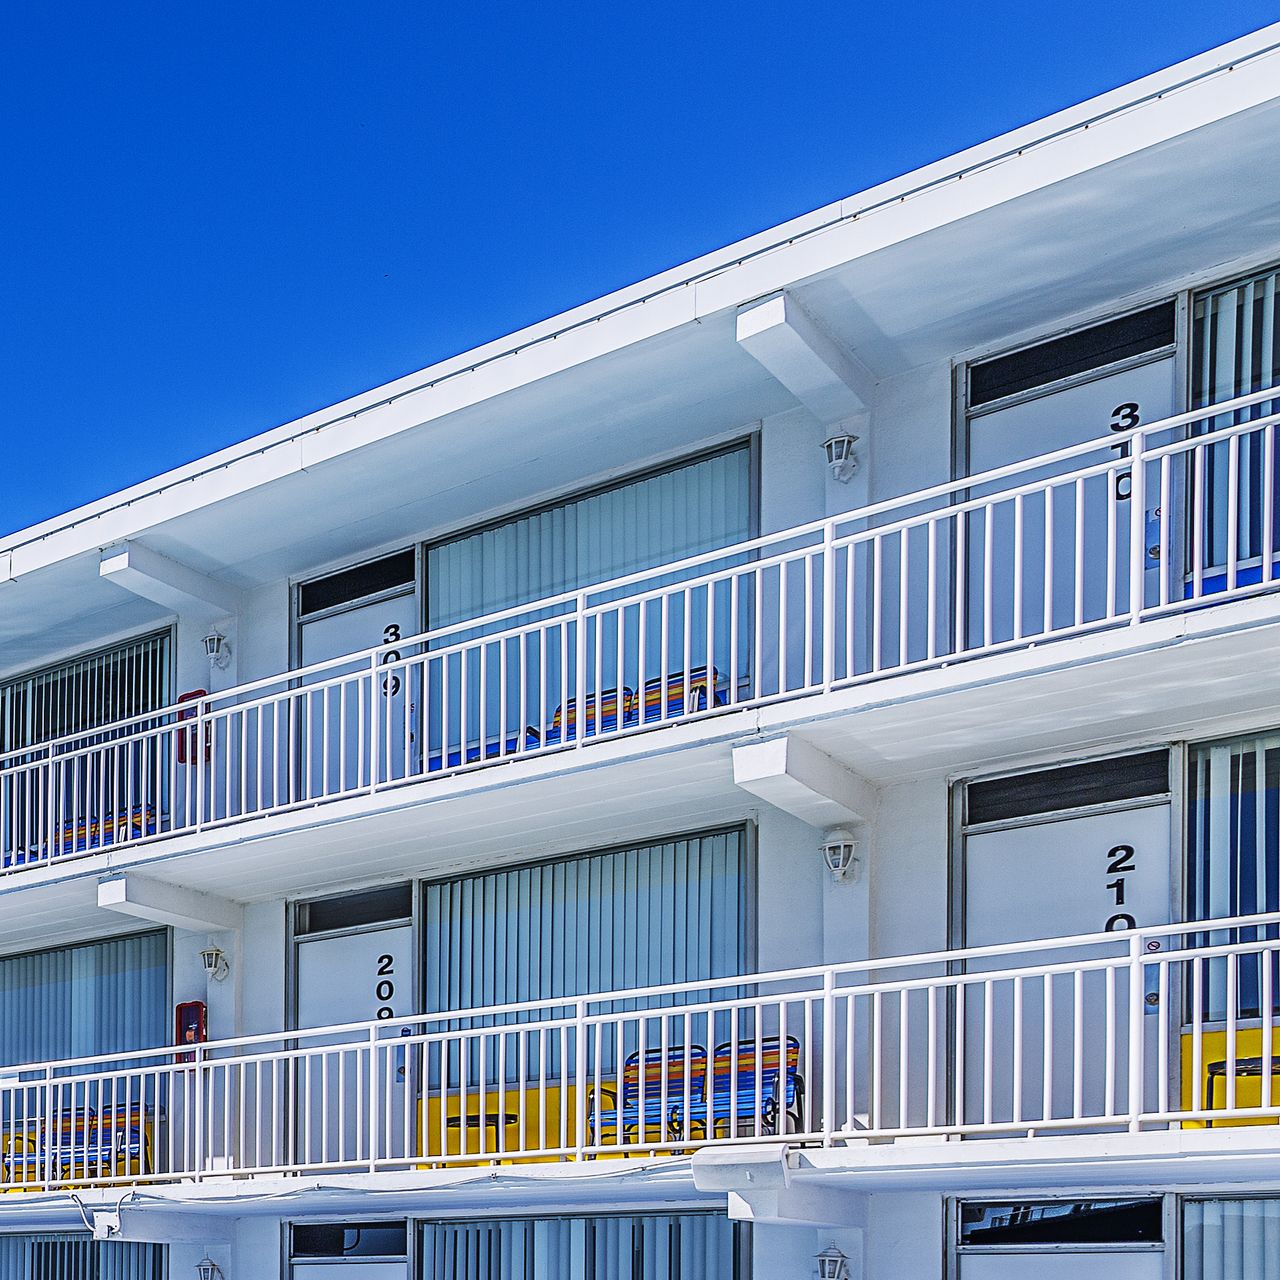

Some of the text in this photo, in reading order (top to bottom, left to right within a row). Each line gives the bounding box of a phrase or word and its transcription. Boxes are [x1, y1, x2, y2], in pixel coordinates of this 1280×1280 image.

[1109, 402, 1140, 501] 310
[383, 624, 401, 697] 309
[1105, 845, 1136, 932] 210
[376, 954, 394, 1021] 209
